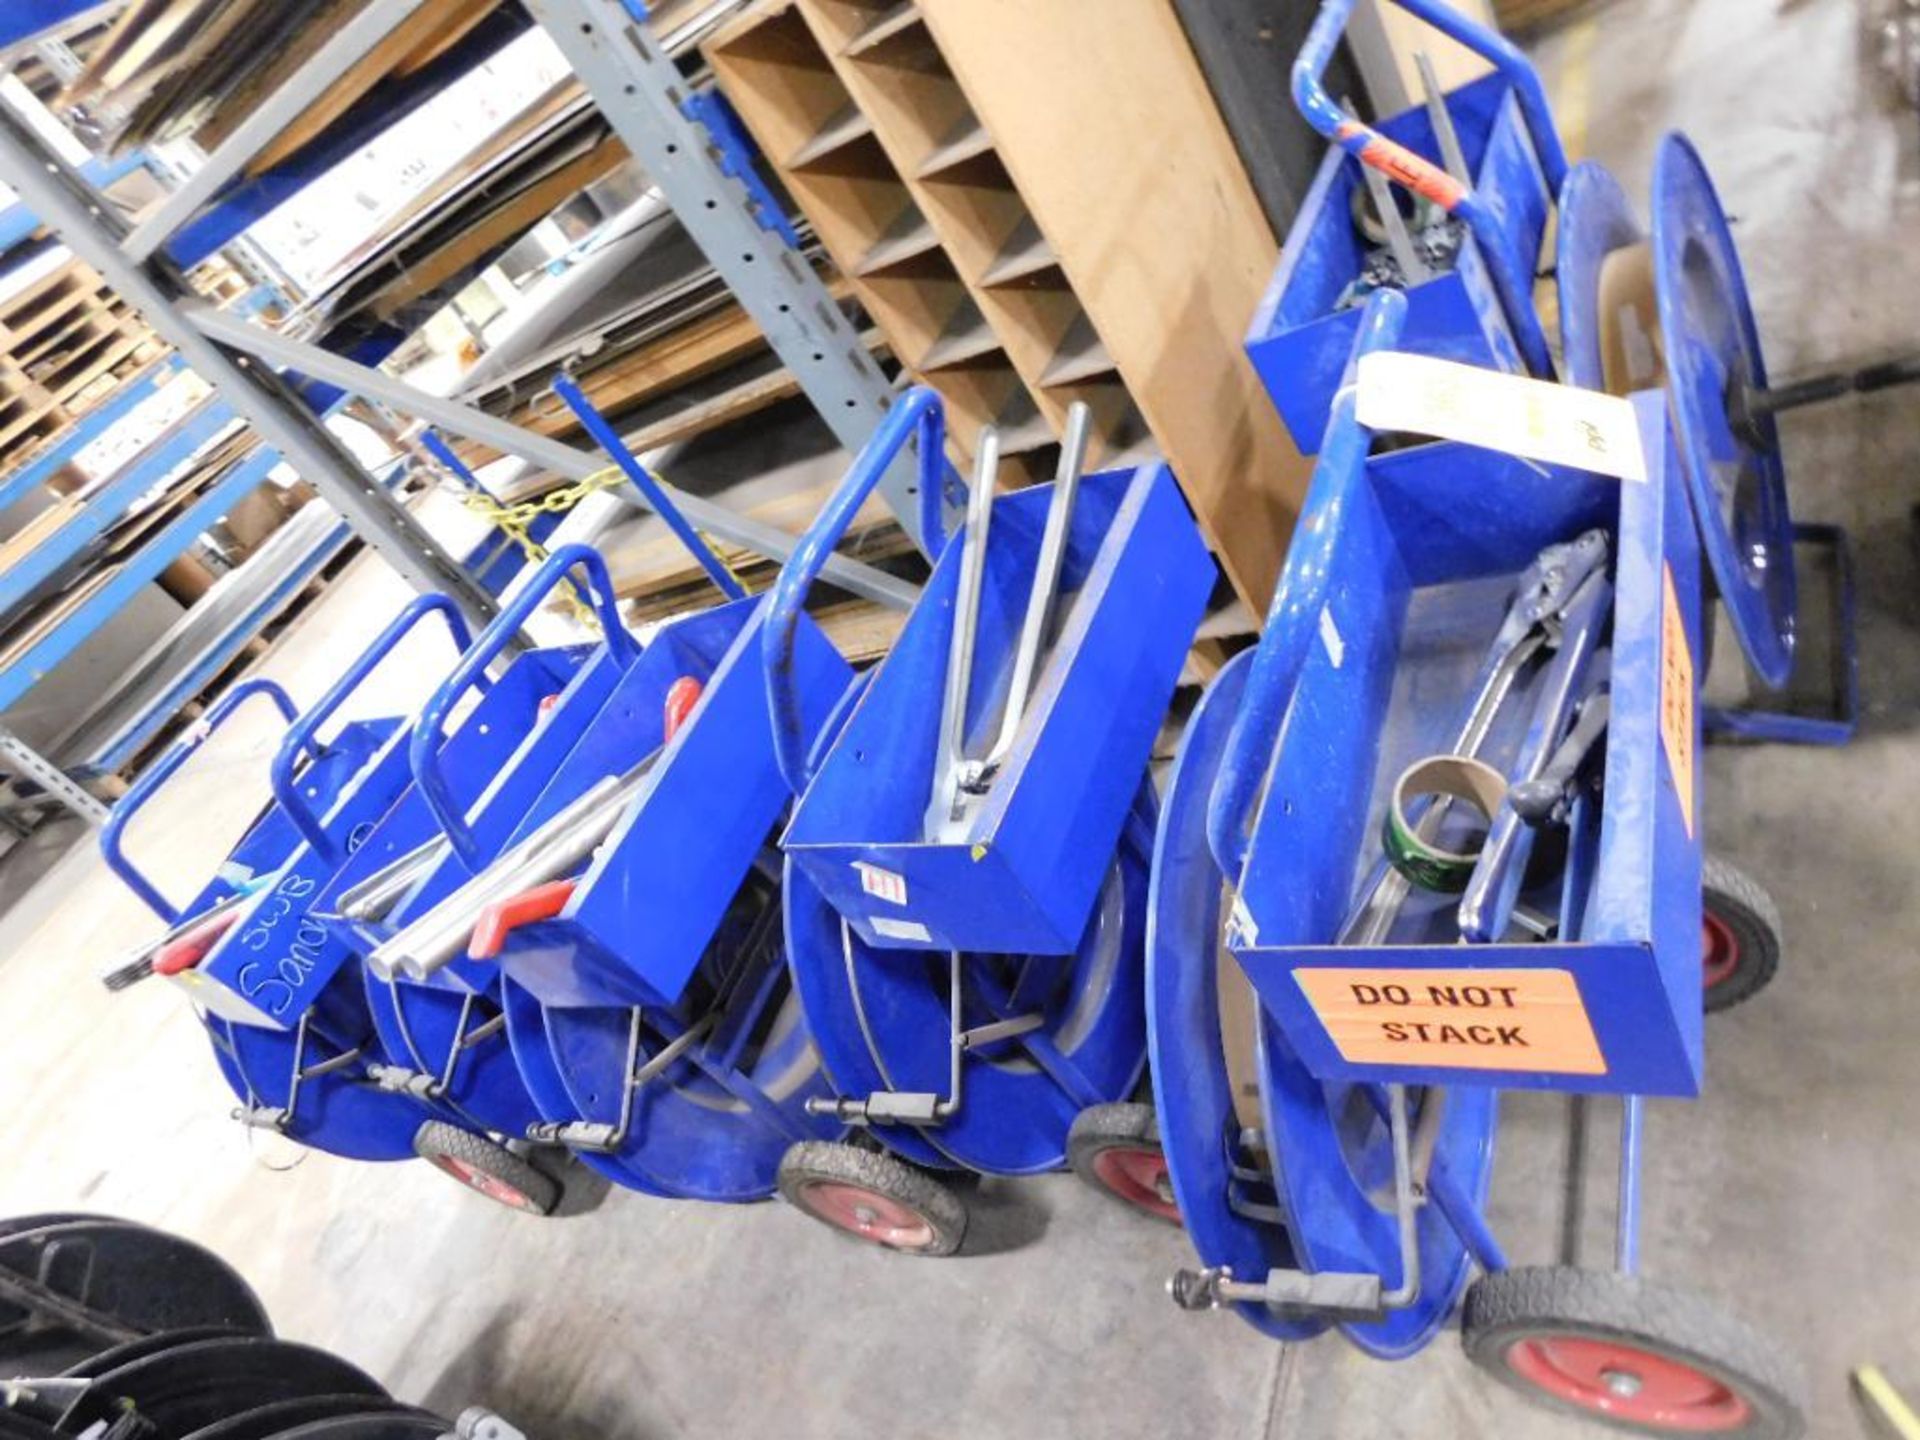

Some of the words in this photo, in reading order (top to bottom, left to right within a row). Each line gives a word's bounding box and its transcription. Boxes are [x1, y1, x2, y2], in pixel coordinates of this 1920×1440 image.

[1349, 983, 1411, 1005] DO
[1426, 984, 1518, 1008] NOT
[1380, 1021, 1530, 1046] STACK
